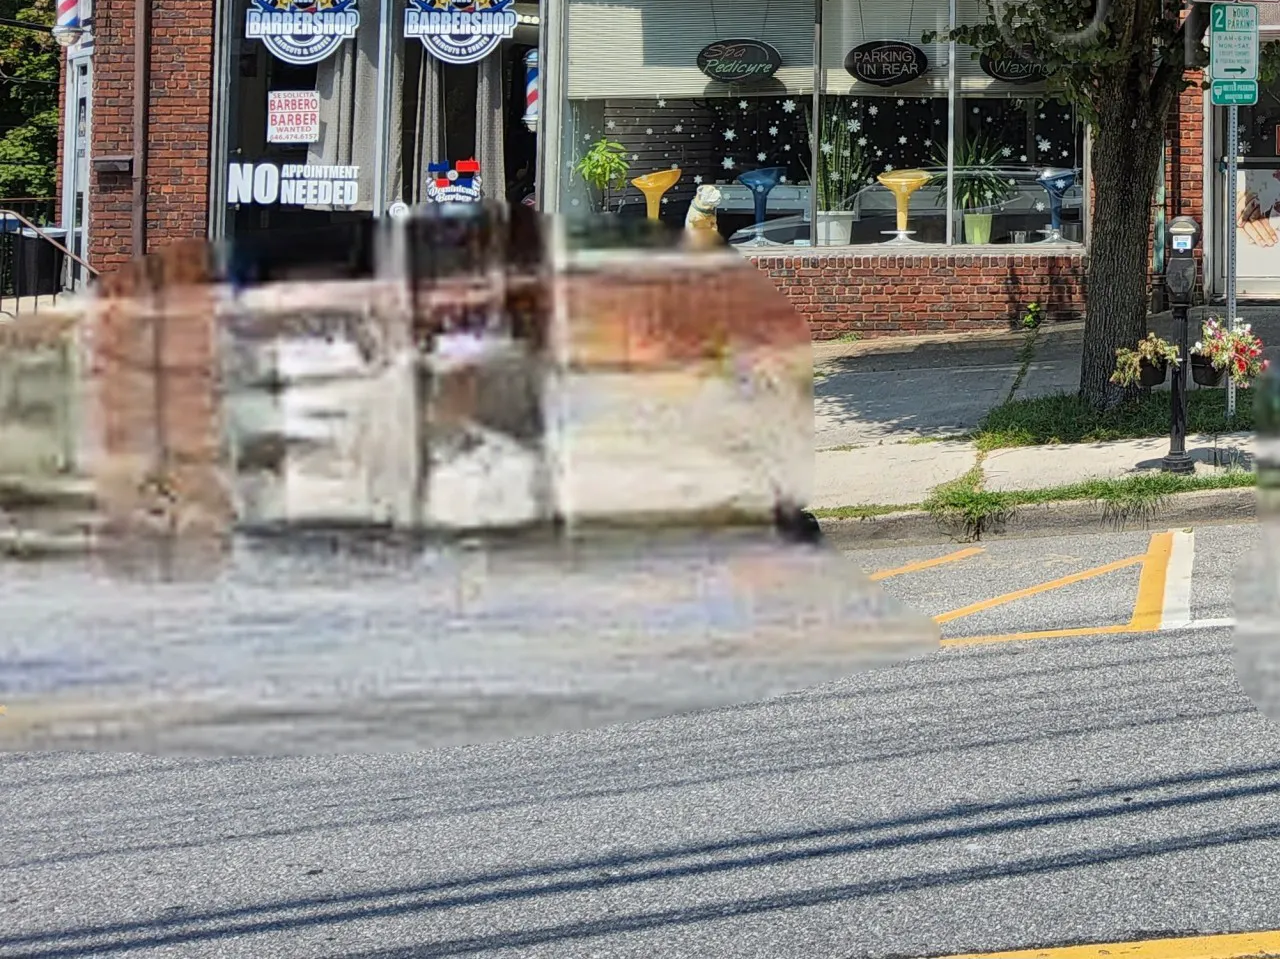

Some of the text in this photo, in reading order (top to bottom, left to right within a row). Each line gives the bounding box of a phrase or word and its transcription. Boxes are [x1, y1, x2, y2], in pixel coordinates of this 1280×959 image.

[1215, 8, 1224, 28] 2
[1232, 7, 1250, 18] HOUR
[249, 11, 357, 35] BARBERSHOP
[408, 11, 515, 35] BARBERSHOP
[1227, 19, 1255, 29] PARKING
[703, 44, 747, 61] Spa
[854, 50, 913, 63] PARKING
[703, 58, 773, 74] Pedicure
[863, 61, 919, 74] IN REAR
[269, 99, 318, 111] BARBERO
[270, 113, 318, 126] BARBER
[281, 164, 360, 178] APPOINTMENT
[227, 162, 279, 204] NO
[280, 180, 359, 205] NEEDED
